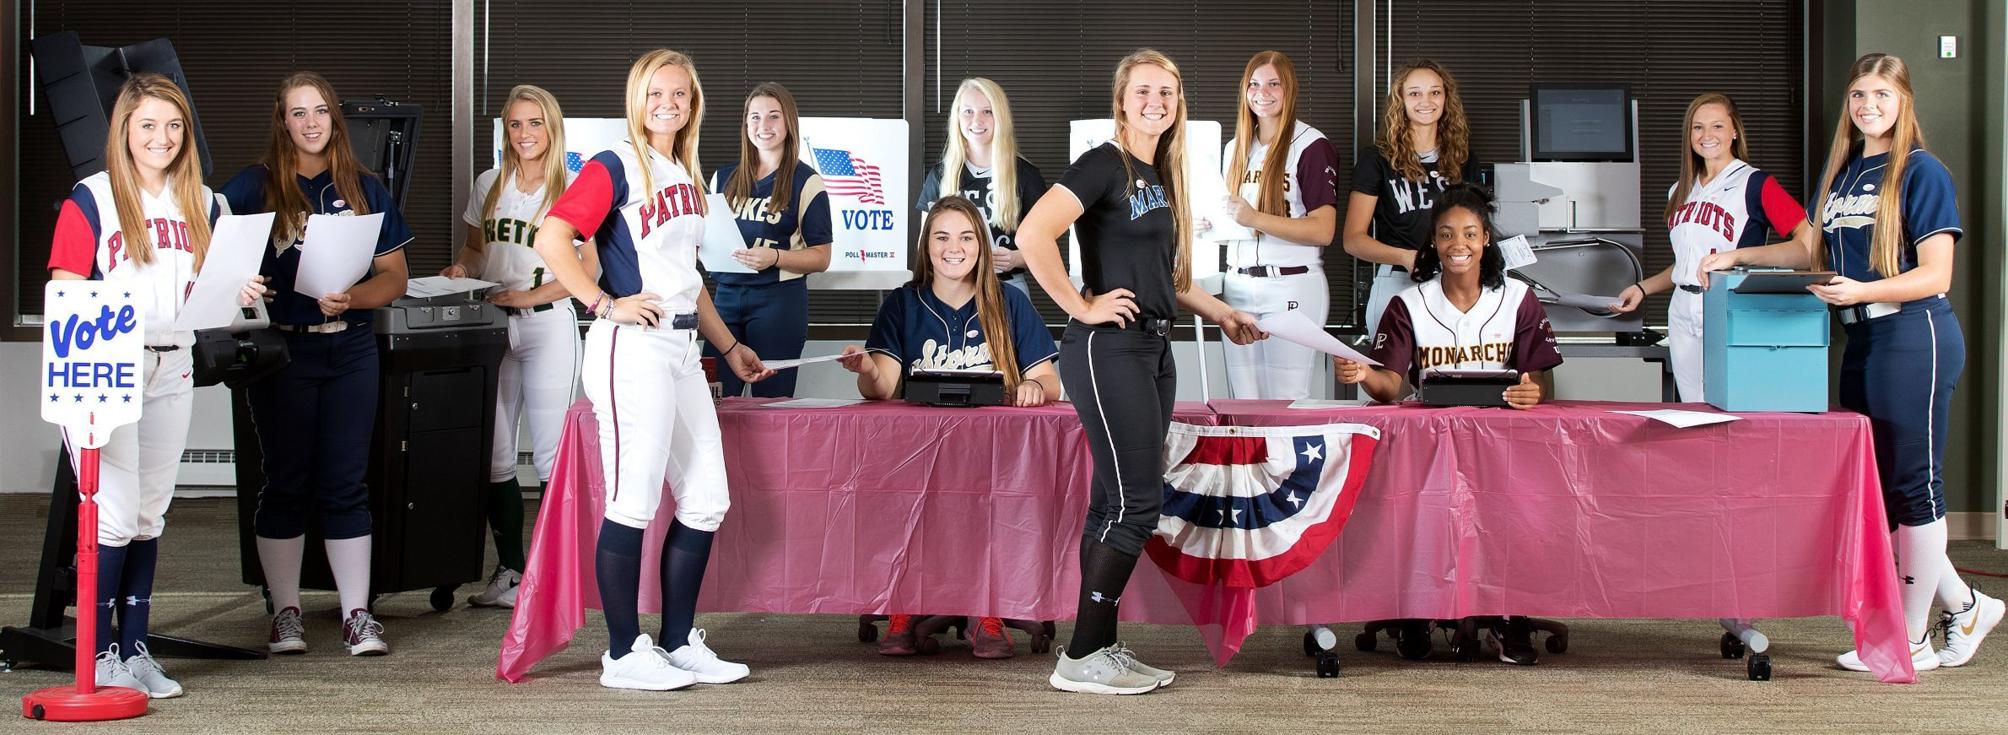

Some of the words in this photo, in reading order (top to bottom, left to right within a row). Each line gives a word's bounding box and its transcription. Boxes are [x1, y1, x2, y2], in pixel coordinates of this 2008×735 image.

[842, 209, 894, 230] VOTE
[845, 251, 860, 259] POLL
[865, 251, 888, 259] MASTER
[50, 304, 137, 359] Vote
[48, 362, 135, 388] HERE
